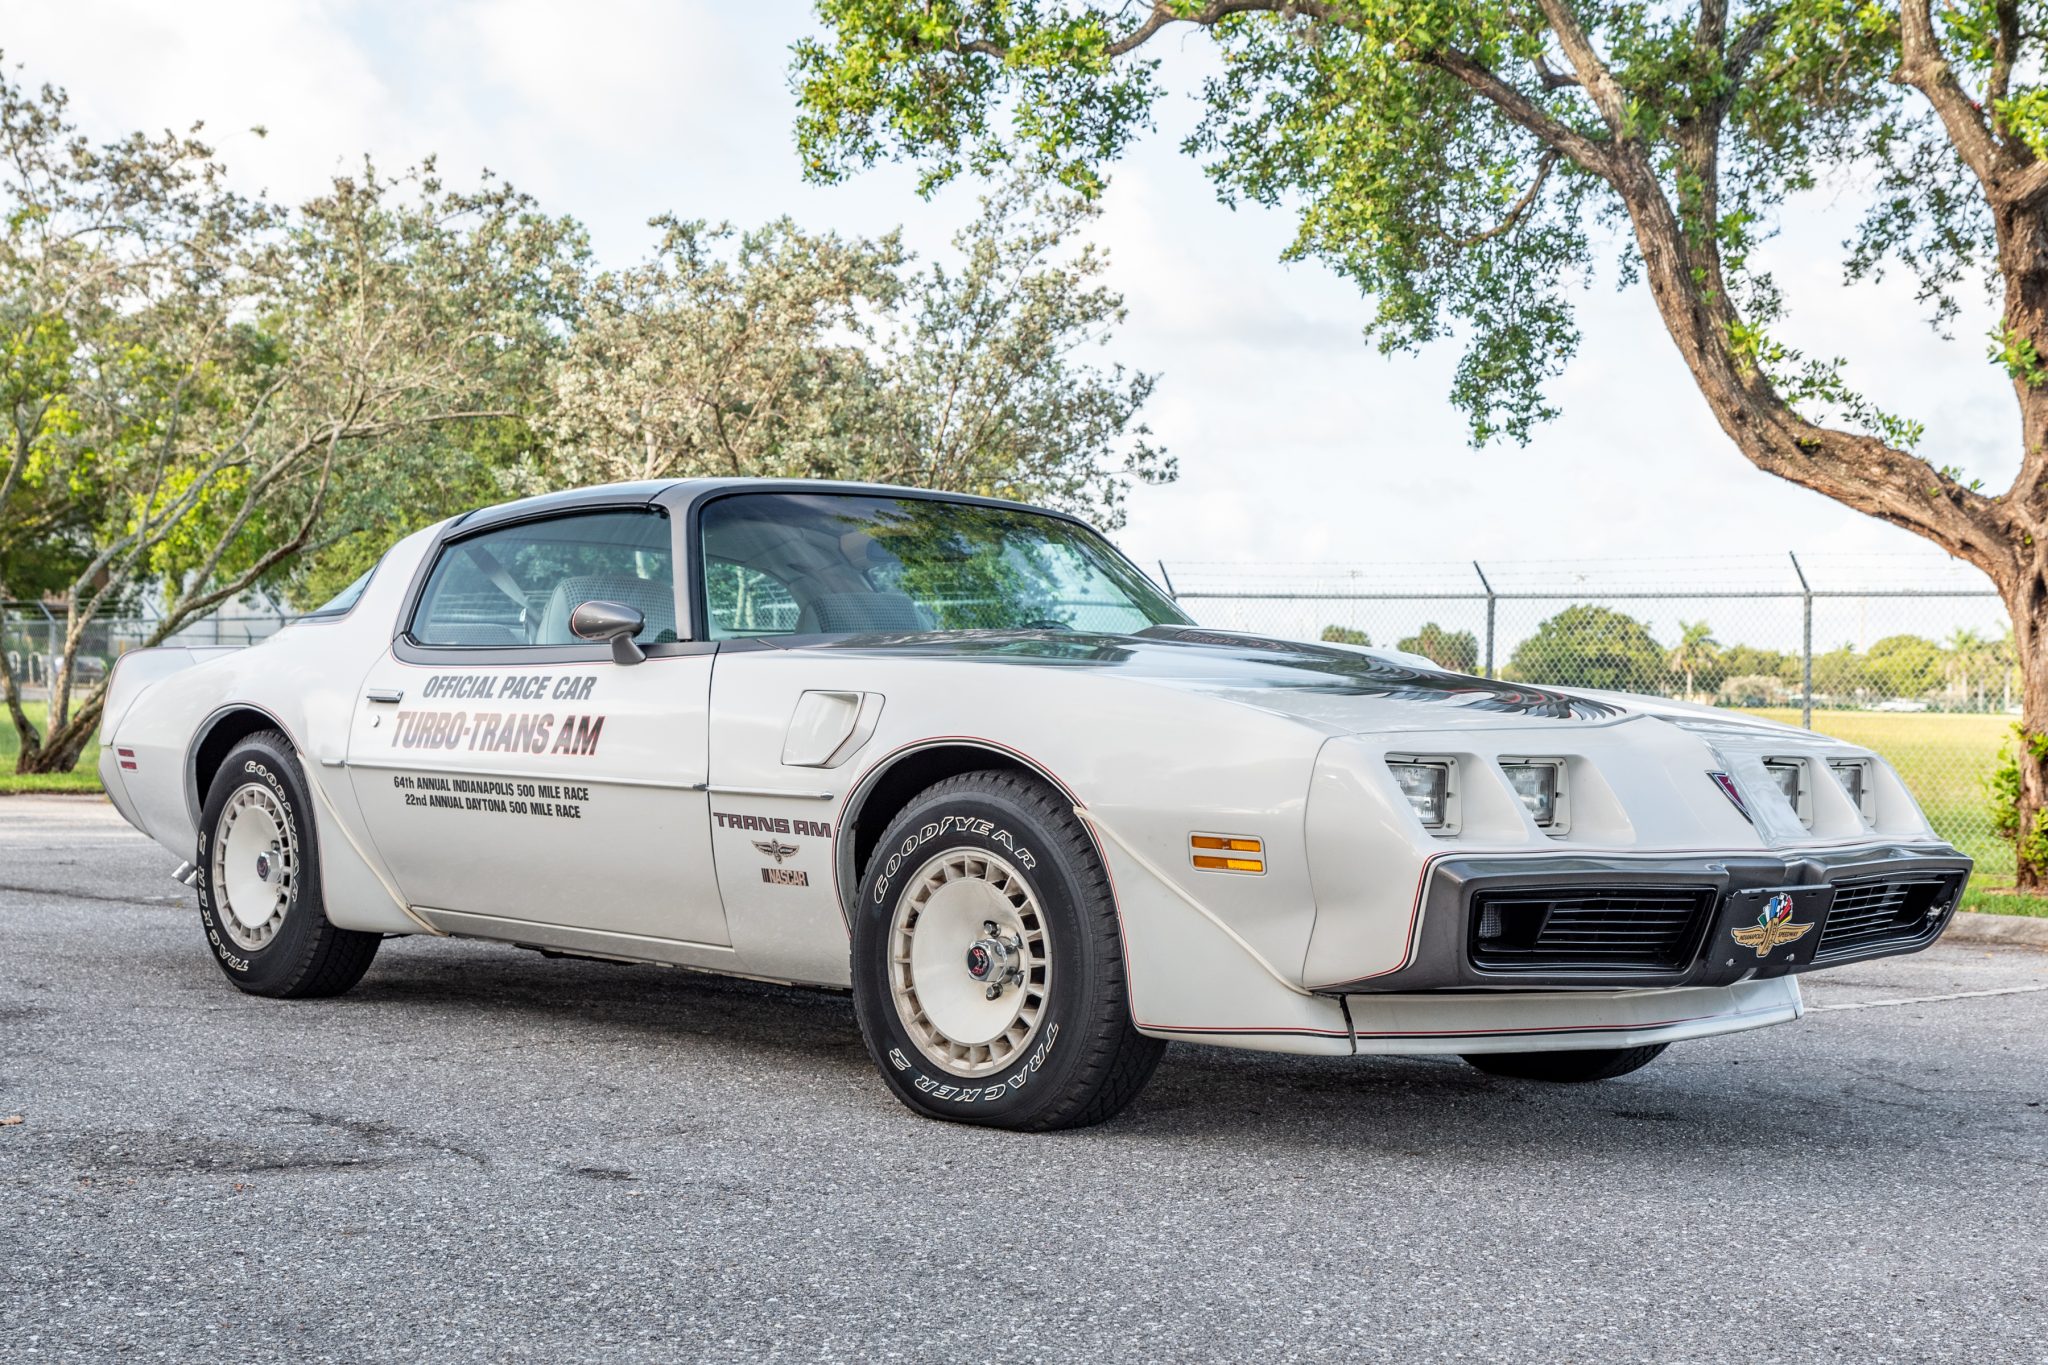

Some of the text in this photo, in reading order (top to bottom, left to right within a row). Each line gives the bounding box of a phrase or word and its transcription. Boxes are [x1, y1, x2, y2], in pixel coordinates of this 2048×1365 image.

[422, 675, 597, 700] OFFICIAL PACE CAR
[391, 711, 605, 756] TURBO-TRANS AM
[394, 776, 589, 801] 64th ANNUAL INDIANAPOLIS 500 MILE RACE
[405, 793, 581, 819] 22nd ANNUAL DAYTONA 500 MILE RACE
[244, 760, 300, 903] GOODYEAR
[713, 812, 832, 838] TRANS AM
[768, 869, 807, 886] NASCAR
[874, 816, 1036, 904] GOODYEAR
[197, 865, 249, 972] TRACKER
[889, 1022, 1059, 1103] TRACKER 2
